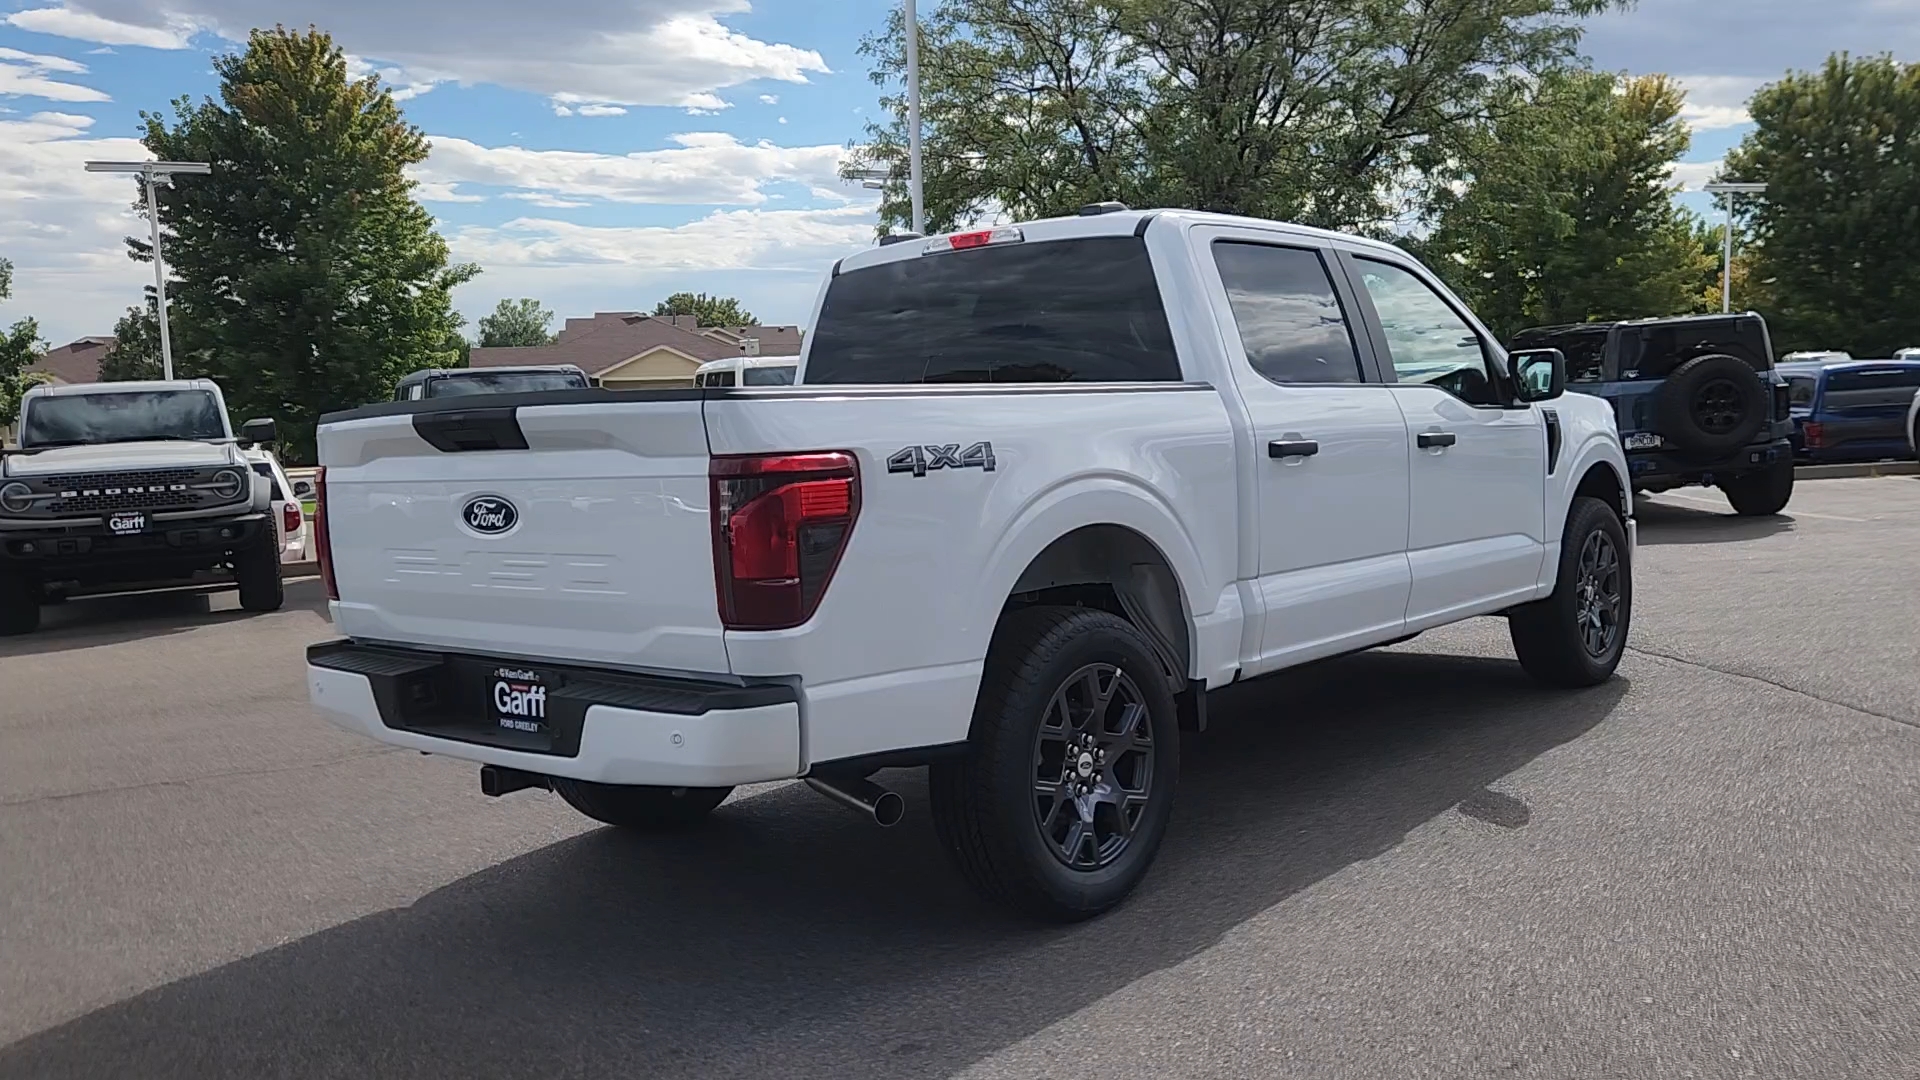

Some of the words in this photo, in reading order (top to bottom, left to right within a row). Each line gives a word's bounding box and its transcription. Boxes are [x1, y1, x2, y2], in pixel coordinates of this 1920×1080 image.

[60, 484, 186, 498] BRONCO
[470, 501, 505, 527] Ford
[109, 516, 145, 530] Garff
[494, 681, 546, 718] Garff
[500, 718, 514, 728] FORD
[515, 720, 538, 732] GREELEY
